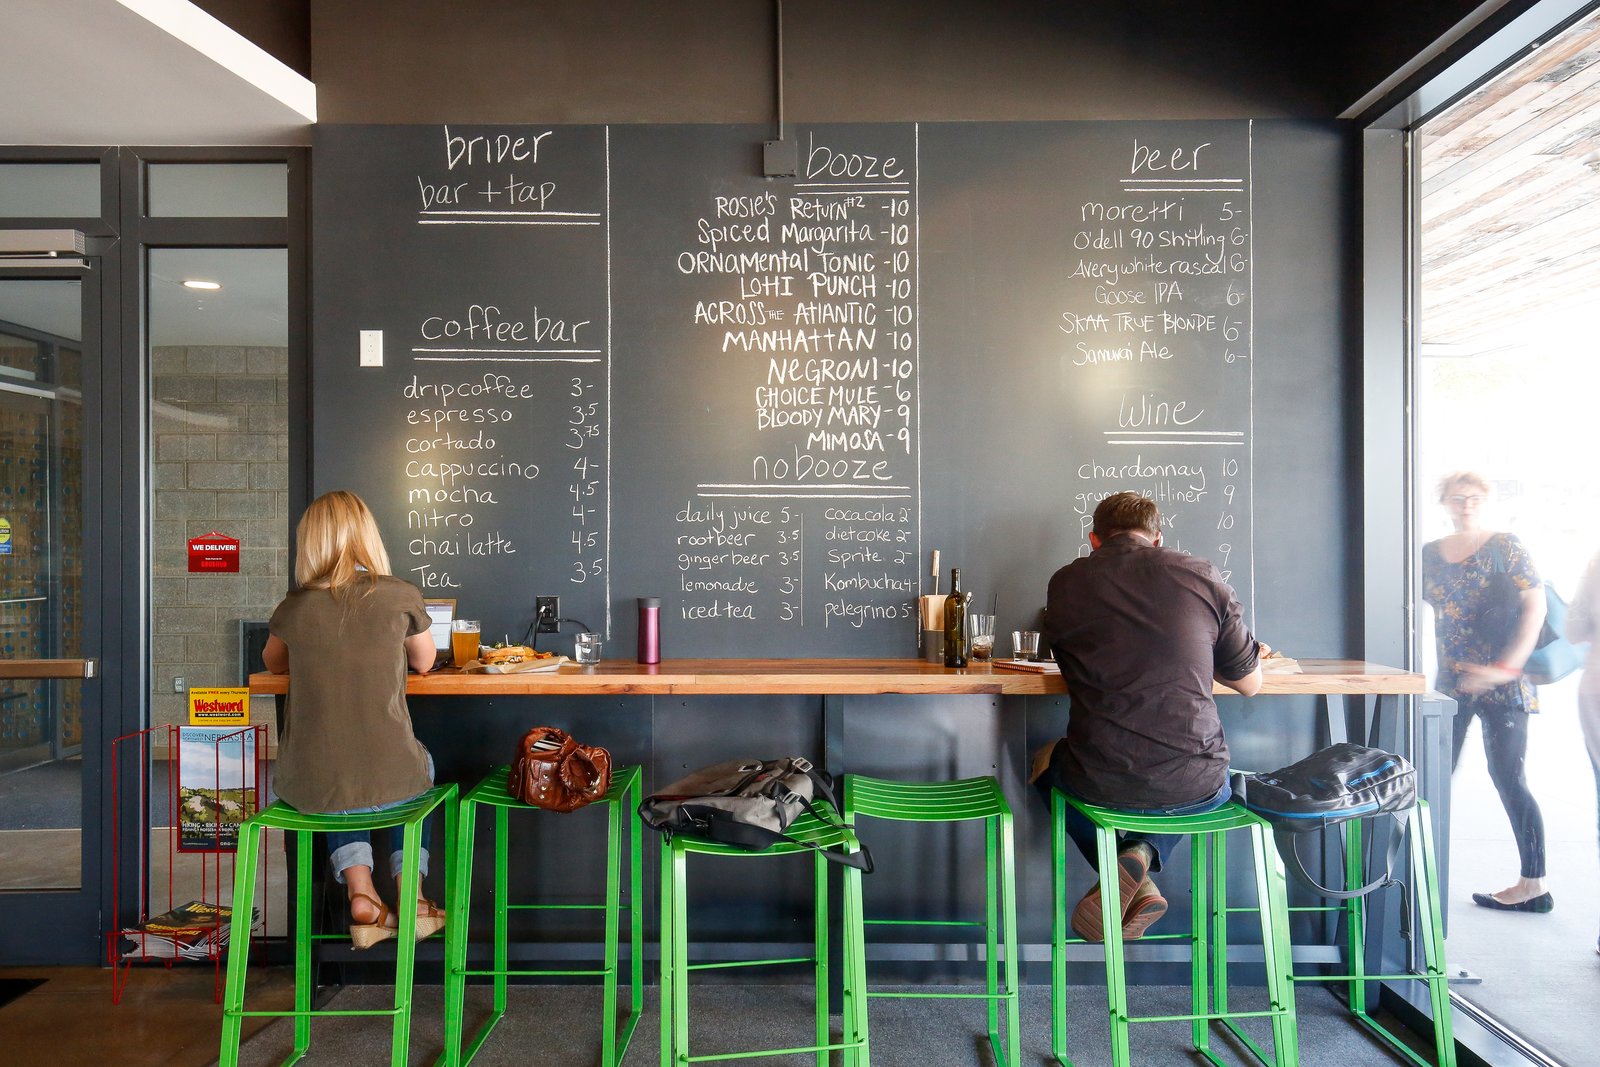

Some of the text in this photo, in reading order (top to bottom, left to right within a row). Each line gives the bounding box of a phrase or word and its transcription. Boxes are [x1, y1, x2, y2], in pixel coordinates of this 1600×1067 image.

[806, 131, 904, 179] booze
[1131, 138, 1211, 174] beer
[418, 175, 468, 210] bar
[504, 174, 556, 210] tap
[698, 216, 770, 252] Spiced
[782, 220, 876, 254] Margarita
[1131, 228, 1154, 248] 90
[807, 272, 876, 298] PUNCH
[1154, 281, 1183, 304] IPA
[694, 301, 766, 326] ACROSS
[1113, 312, 1154, 333] TRUE
[1140, 341, 1174, 362] Ale
[755, 386, 825, 408] CHOICE
[828, 386, 879, 405] MULE
[407, 408, 512, 432] espresso
[756, 407, 823, 431] BLOODY
[827, 405, 881, 429] MARY
[406, 430, 496, 453] cortado
[807, 429, 884, 452] MIMOSA
[406, 455, 539, 486] cappuccino
[1222, 459, 1238, 477] 10
[409, 486, 498, 504] mocha
[408, 508, 473, 529] nitro
[675, 500, 724, 533] daily
[729, 506, 772, 530] juice
[411, 564, 460, 588] Tea
[681, 574, 759, 593] lemonade
[194, 699, 243, 712] Westword
